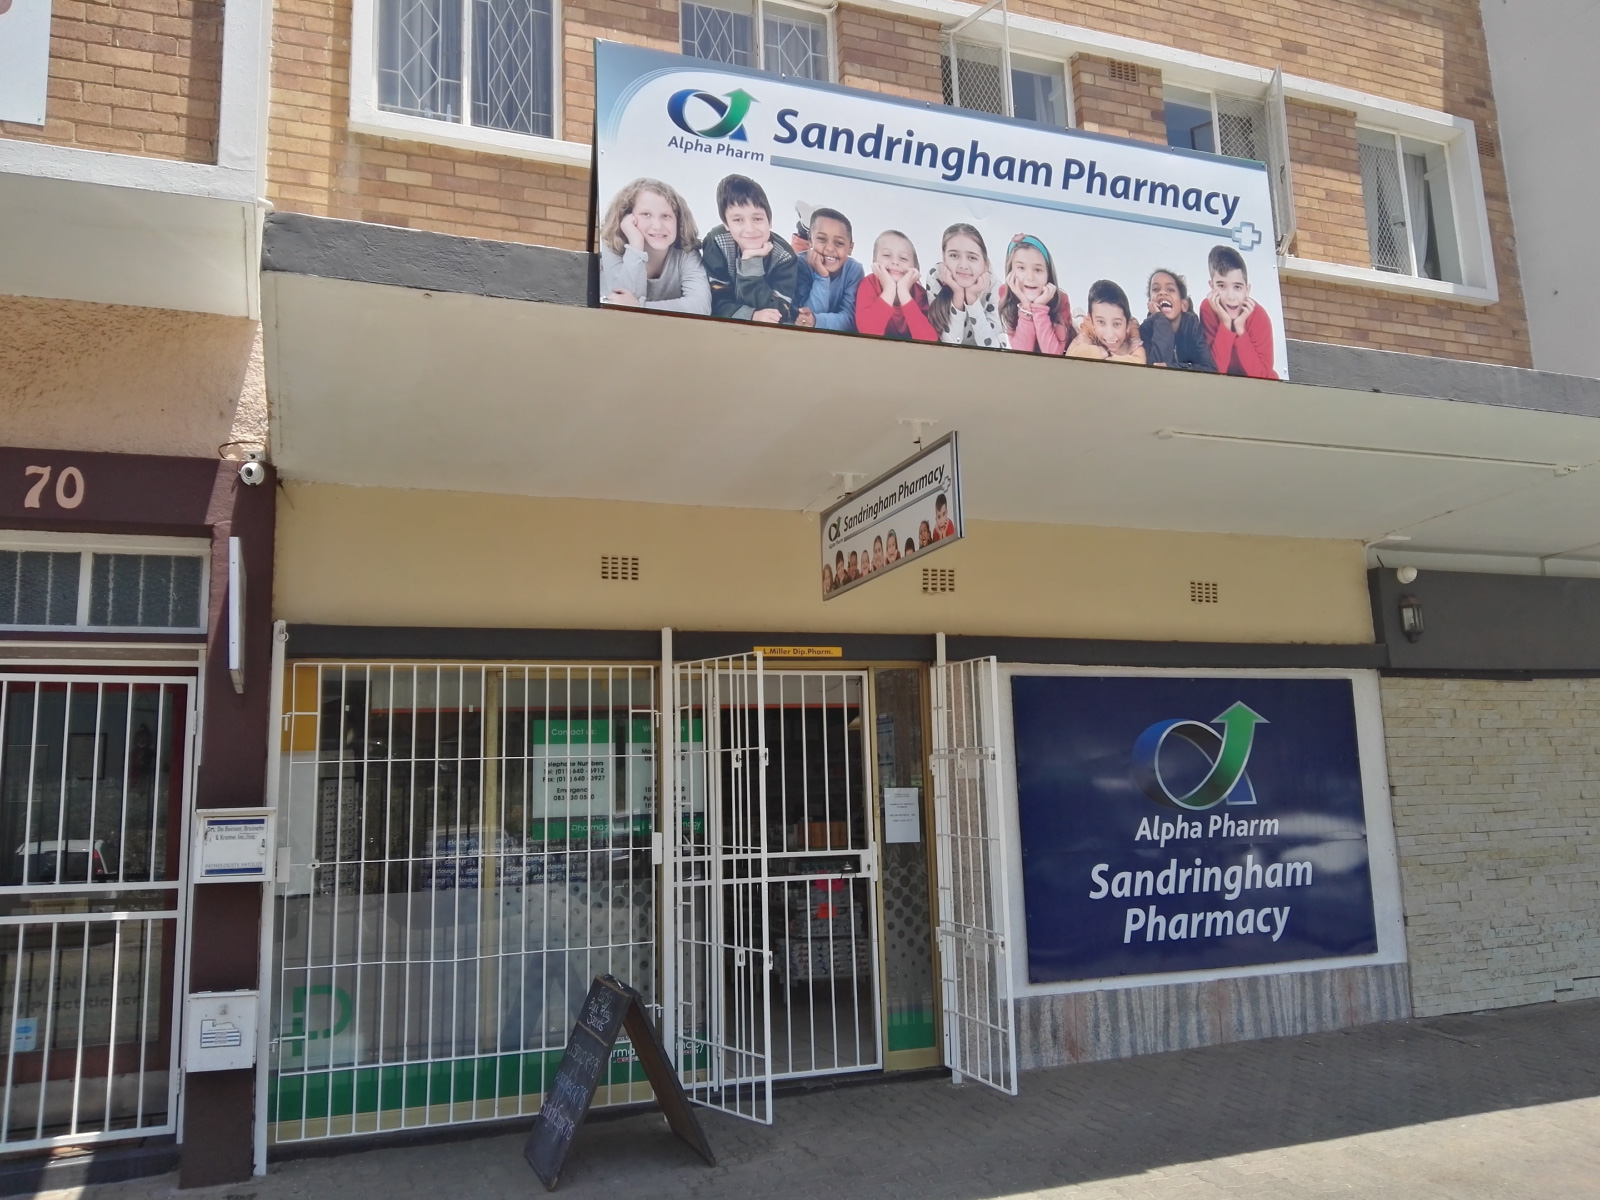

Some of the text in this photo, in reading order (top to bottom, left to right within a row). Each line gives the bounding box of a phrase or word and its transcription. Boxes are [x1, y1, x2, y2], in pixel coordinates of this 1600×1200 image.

[667, 136, 765, 162] Alpha Pharm
[773, 108, 1241, 225] Sandringham Pharmacy
[24, 465, 85, 509] 70
[844, 464, 945, 532] Sandringham Pharmacy
[551, 728, 584, 737] Conact
[1134, 813, 1280, 848] Alpha Pharm
[1089, 854, 1313, 900] Sandringham
[1123, 905, 1291, 943] Pharmacy
